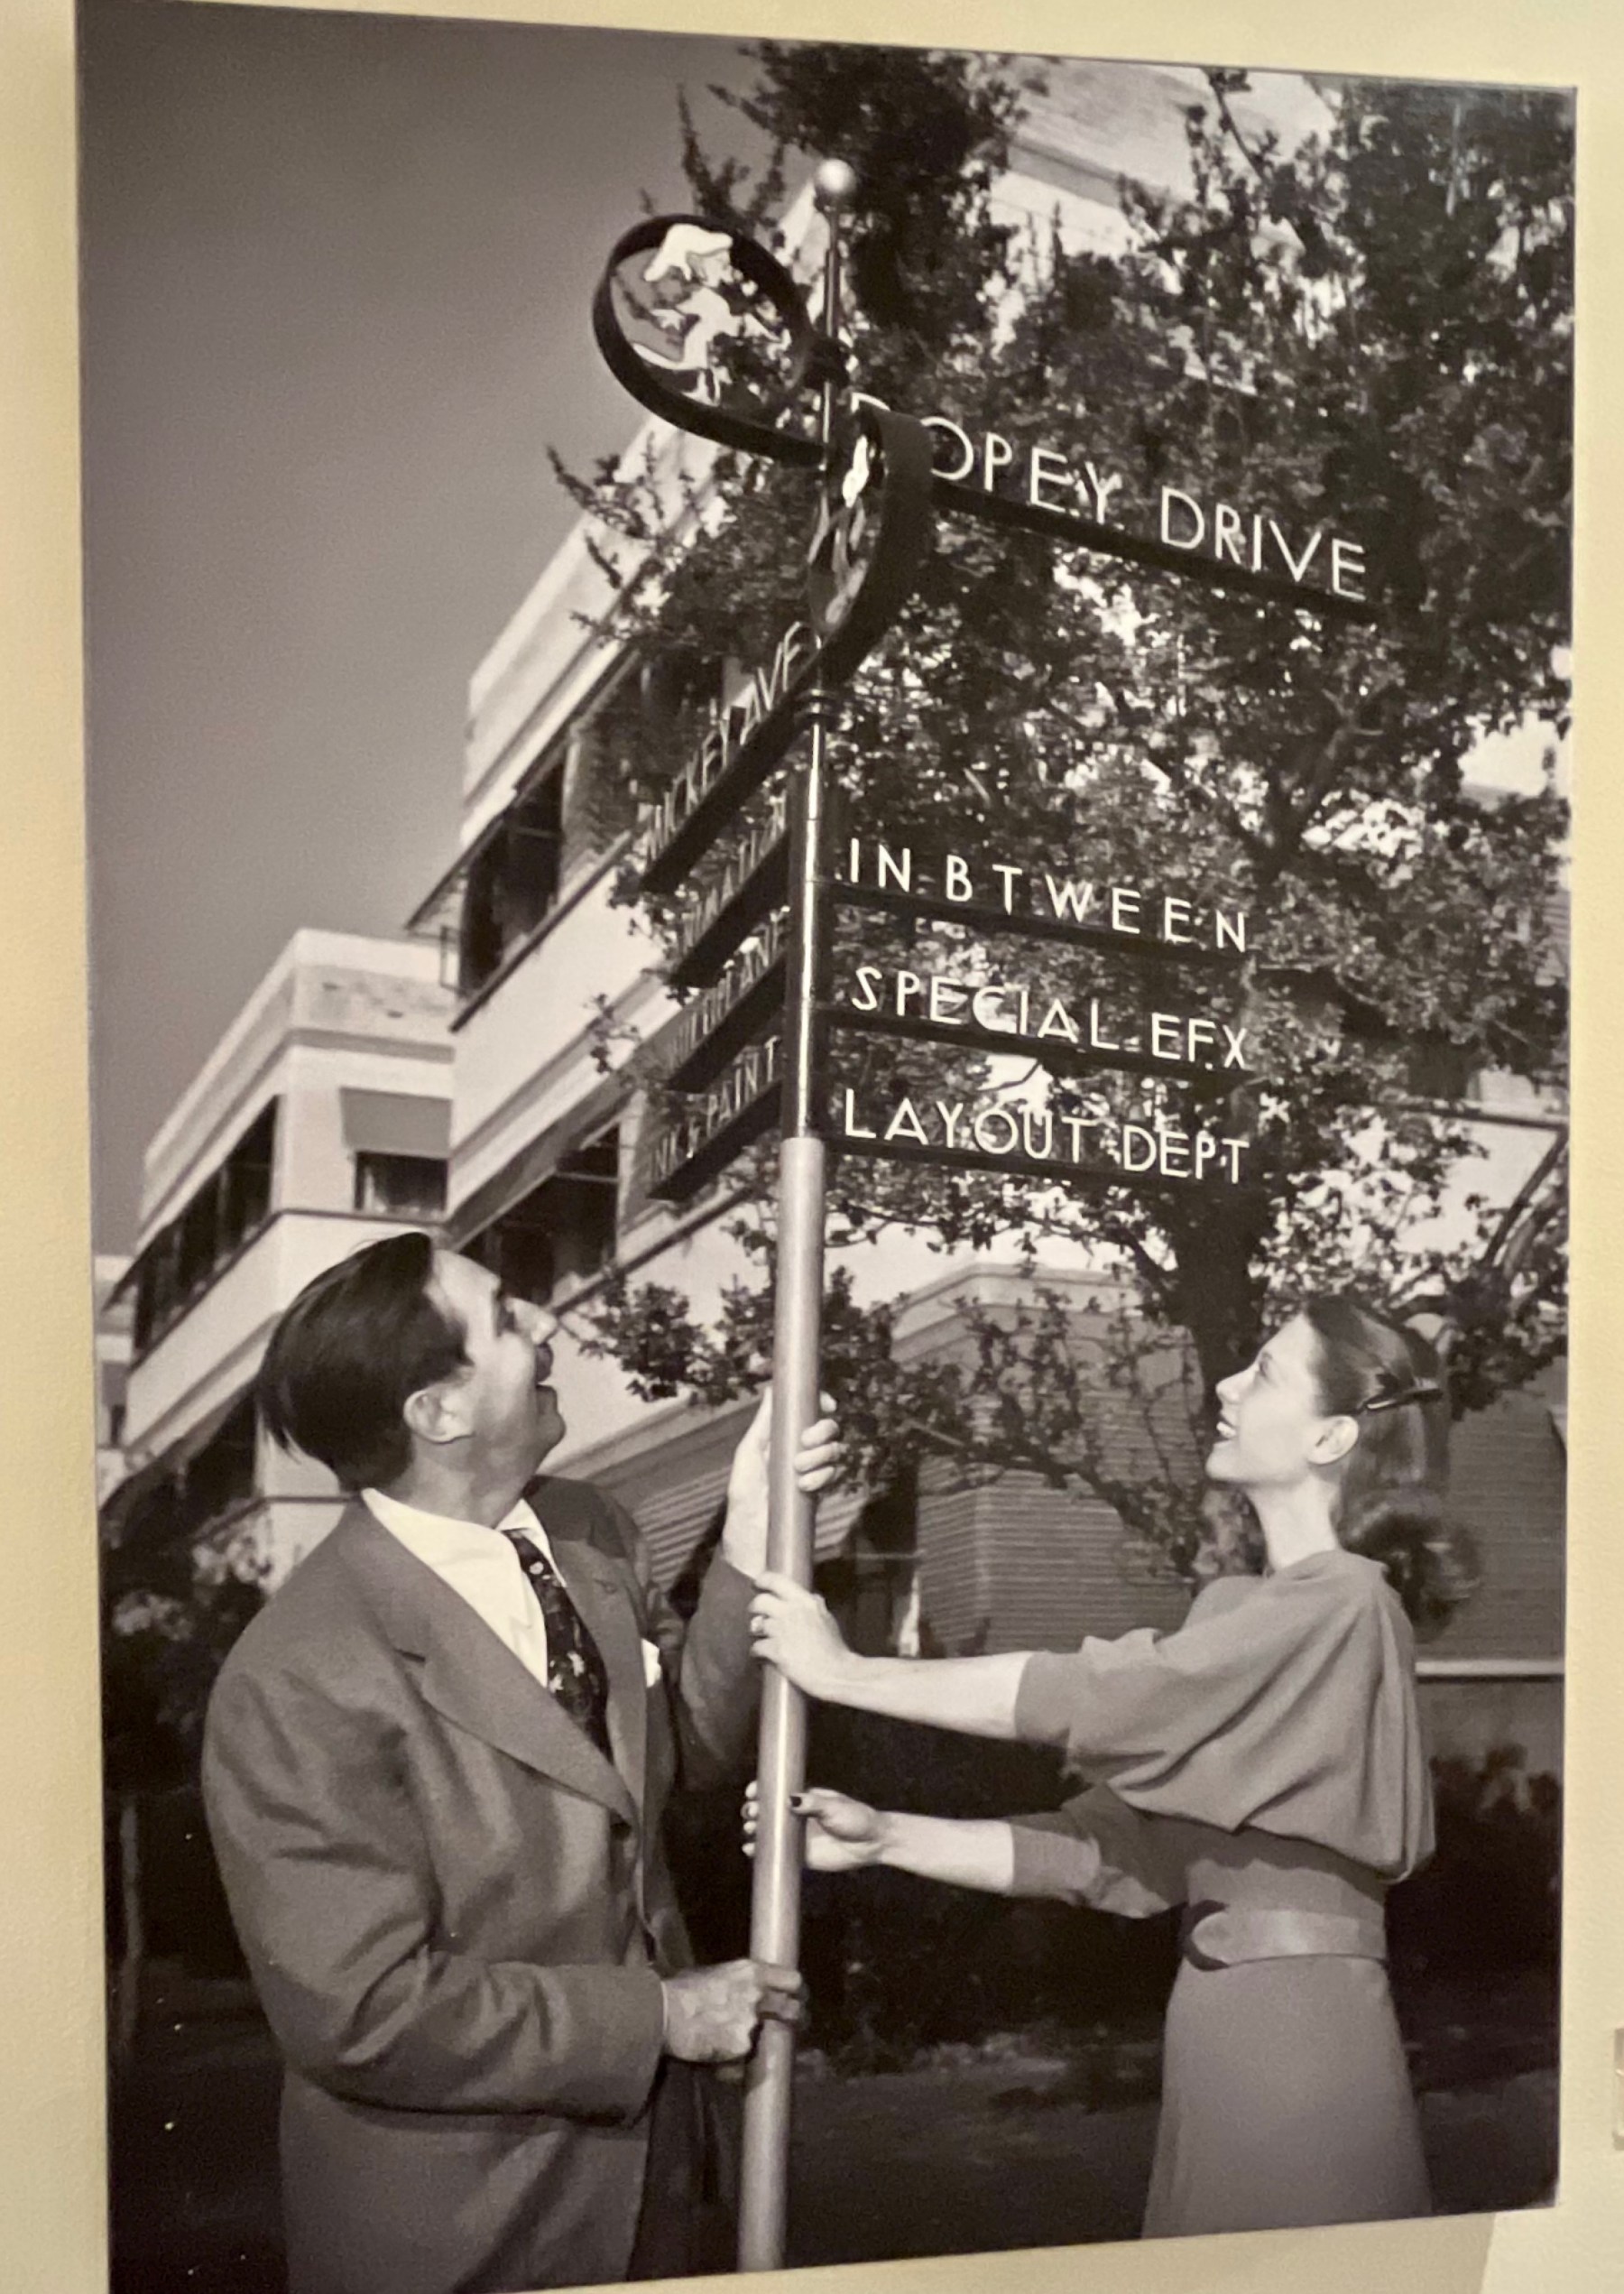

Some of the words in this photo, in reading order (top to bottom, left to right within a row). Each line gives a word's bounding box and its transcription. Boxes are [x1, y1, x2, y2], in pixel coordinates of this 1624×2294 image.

[851, 392, 1122, 525] OPEY
[1160, 485, 1368, 602] DRIVE
[851, 967, 1120, 1050] SPECIAL
[1151, 1012, 1248, 1069] EFX
[844, 1087, 1096, 1164] LAYOUT
[1121, 1124, 1250, 1184] DEPT
